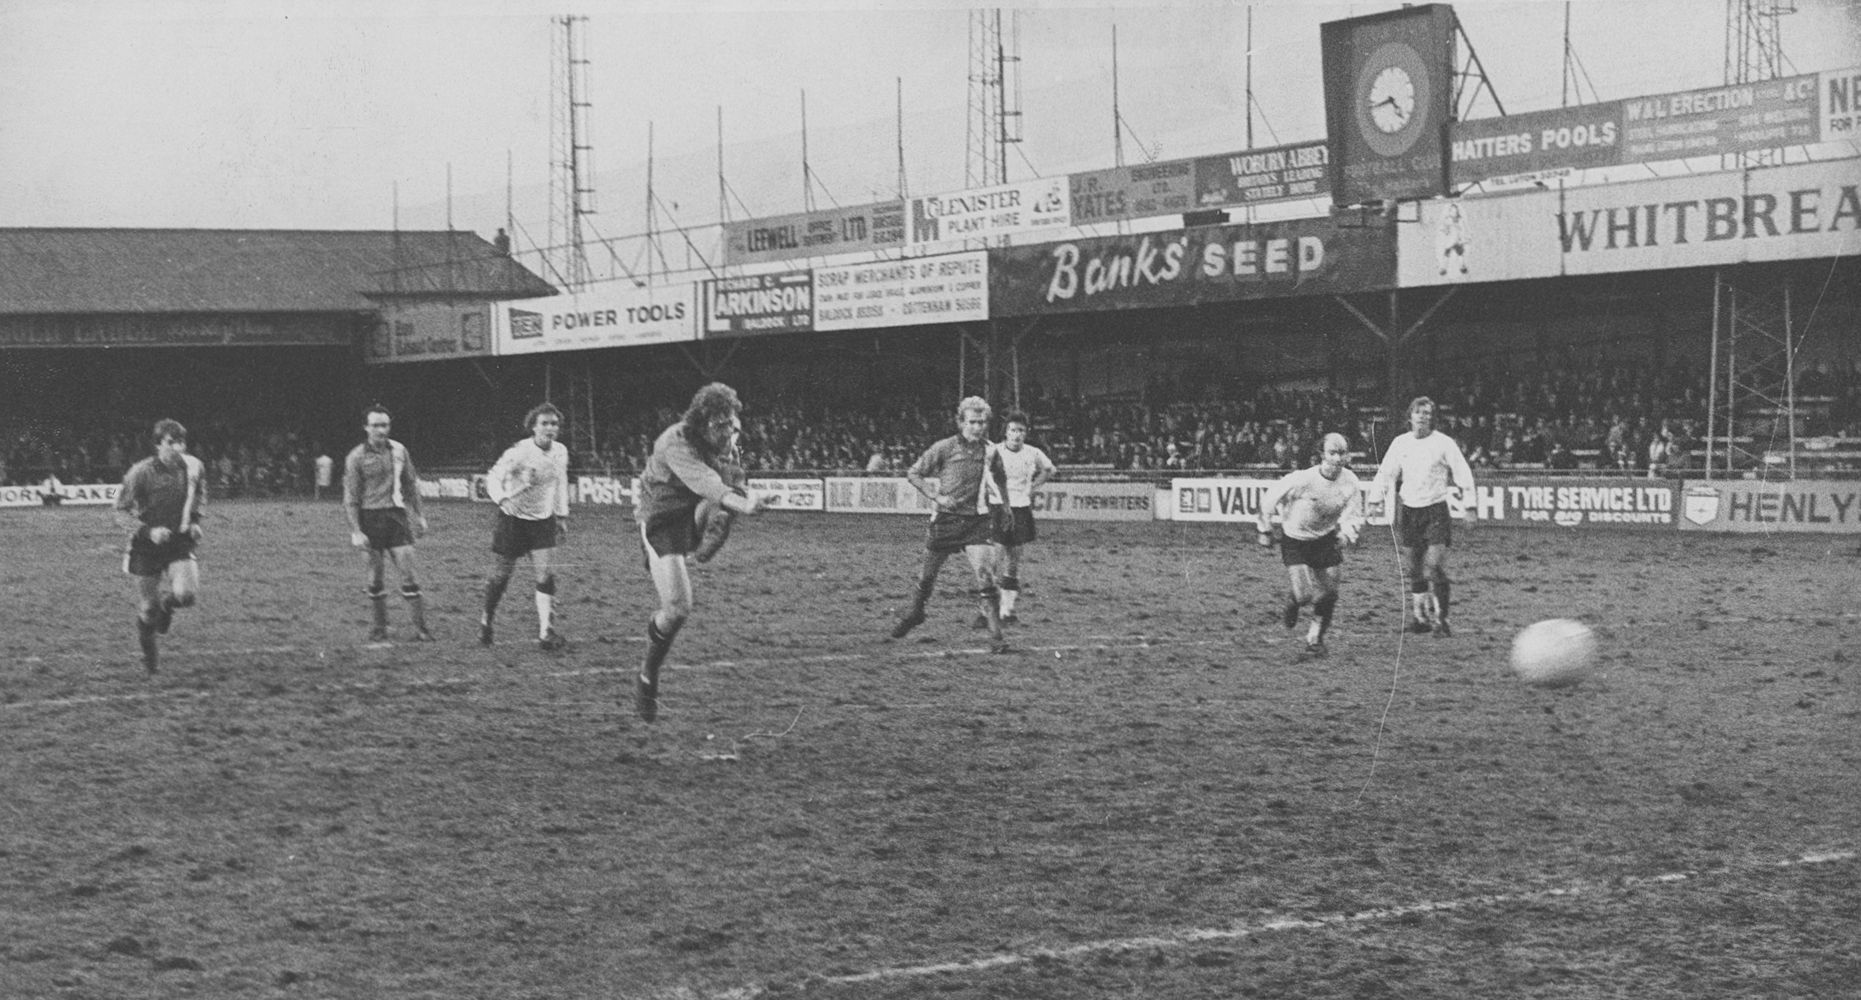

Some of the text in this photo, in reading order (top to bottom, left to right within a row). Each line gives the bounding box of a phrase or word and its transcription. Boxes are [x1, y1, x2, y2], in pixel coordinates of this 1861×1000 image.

[1671, 88, 1753, 115] ERECTION
[1452, 133, 1532, 162] HATTERS
[1541, 121, 1617, 150] POOLS
[1229, 151, 1286, 176] WOBURN
[1288, 145, 1329, 169] ABBEY
[1283, 167, 1323, 182] LEADING
[927, 189, 1021, 219] GLENISTER
[1072, 189, 1126, 219] YATES
[842, 216, 867, 242] LTD
[949, 217, 986, 233] PLANT
[991, 212, 1020, 227] HIRE
[818, 259, 981, 288] SCRAP MERCHANTS OF REPUTE
[1046, 236, 1325, 302] Banks' SEED
[552, 309, 617, 330] POWER
[626, 302, 685, 324] TOOLS
[792, 314, 810, 326] LTD
[818, 307, 853, 321] BALDOCK
[902, 300, 951, 315] COTTENHAM
[1072, 495, 1150, 511] TYPEWRITERS
[1217, 486, 1269, 515] VAU
[1508, 486, 1554, 509] TYRE
[1556, 486, 1634, 511] SERVICE
[1635, 487, 1672, 511] LTD
[1729, 492, 1861, 523] HENLY
[1522, 510, 1550, 521] FOR
[1588, 512, 1672, 523] DISCOUNTS
